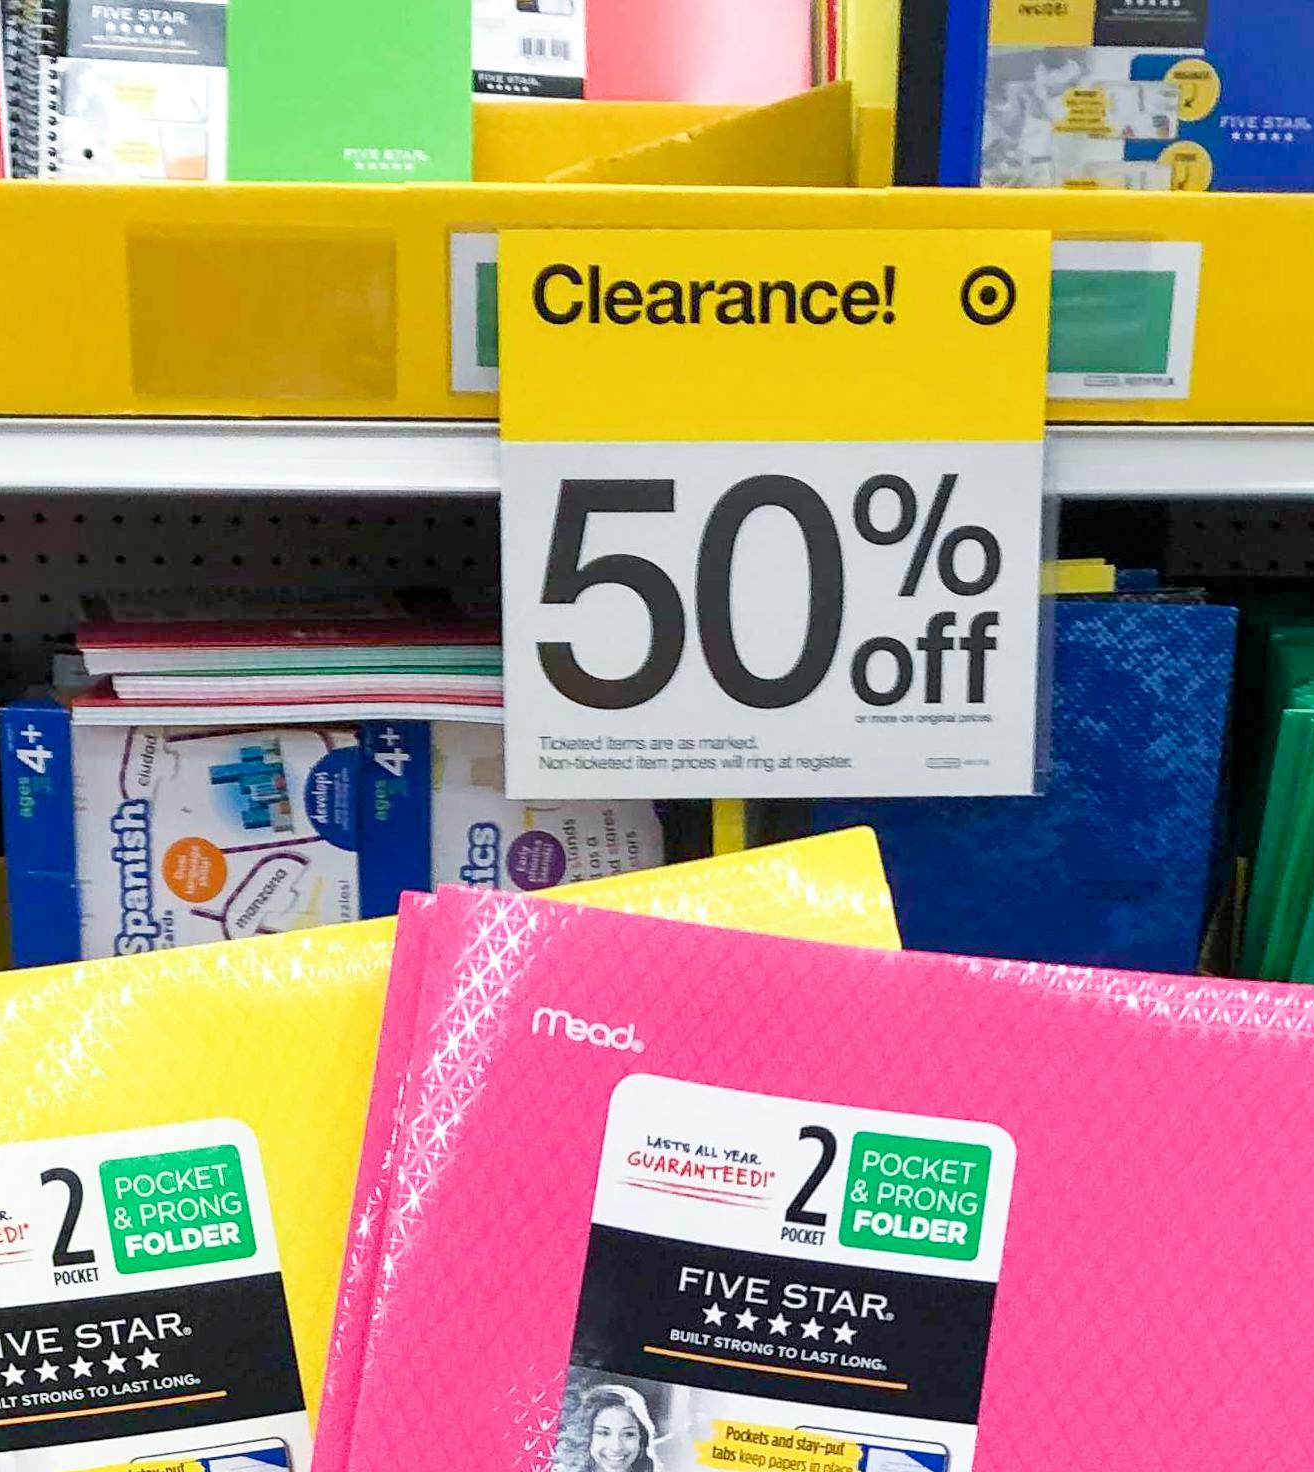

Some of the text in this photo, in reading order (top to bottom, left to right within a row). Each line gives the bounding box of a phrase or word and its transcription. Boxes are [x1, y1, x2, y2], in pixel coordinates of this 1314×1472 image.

[532, 262, 898, 326] Clearance!
[850, 610, 1002, 708] off
[17, 724, 54, 775] 4+
[136, 733, 159, 787] ciudad
[374, 727, 412, 777] 4+
[539, 734, 758, 752] Ticketed items are as marked.
[538, 753, 633, 771] Non-ticketed
[635, 753, 667, 770] item
[671, 755, 716, 772] prices
[720, 753, 744, 770] will
[746, 754, 774, 773] ring
[778, 756, 793, 770] at
[309, 771, 331, 825] develops
[112, 797, 158, 957] Spanish
[234, 866, 288, 930] manzana
[645, 1135, 763, 1167] LASTS ALL YEAR.
[861, 1149, 978, 1187] POCKET
[113, 1162, 229, 1201] POCKET
[783, 1124, 839, 1228] 2
[39, 1166, 97, 1268] 2
[113, 1190, 244, 1231] & PRONG
[849, 1179, 979, 1218] & PRONG
[124, 1221, 242, 1259] FOLDER
[780, 1226, 826, 1247] POCKET
[852, 1209, 968, 1247] FOLDER
[52, 1266, 100, 1287] POCKET
[677, 1265, 772, 1306] FIVE
[669, 1328, 710, 1347] BUILT
[713, 1335, 775, 1358] STRONG
[777, 1345, 799, 1360] TO
[800, 1348, 838, 1366] LAST
[20, 1386, 86, 1408] STRONG
[86, 1383, 110, 1400] TO
[110, 1378, 149, 1398] LAST
[713, 1447, 736, 1460] tabs
[740, 1451, 765, 1466] keep
[769, 1457, 806, 1472] papers
[810, 1459, 819, 1471] in
[726, 1426, 845, 1457] Pockets and stay-put
